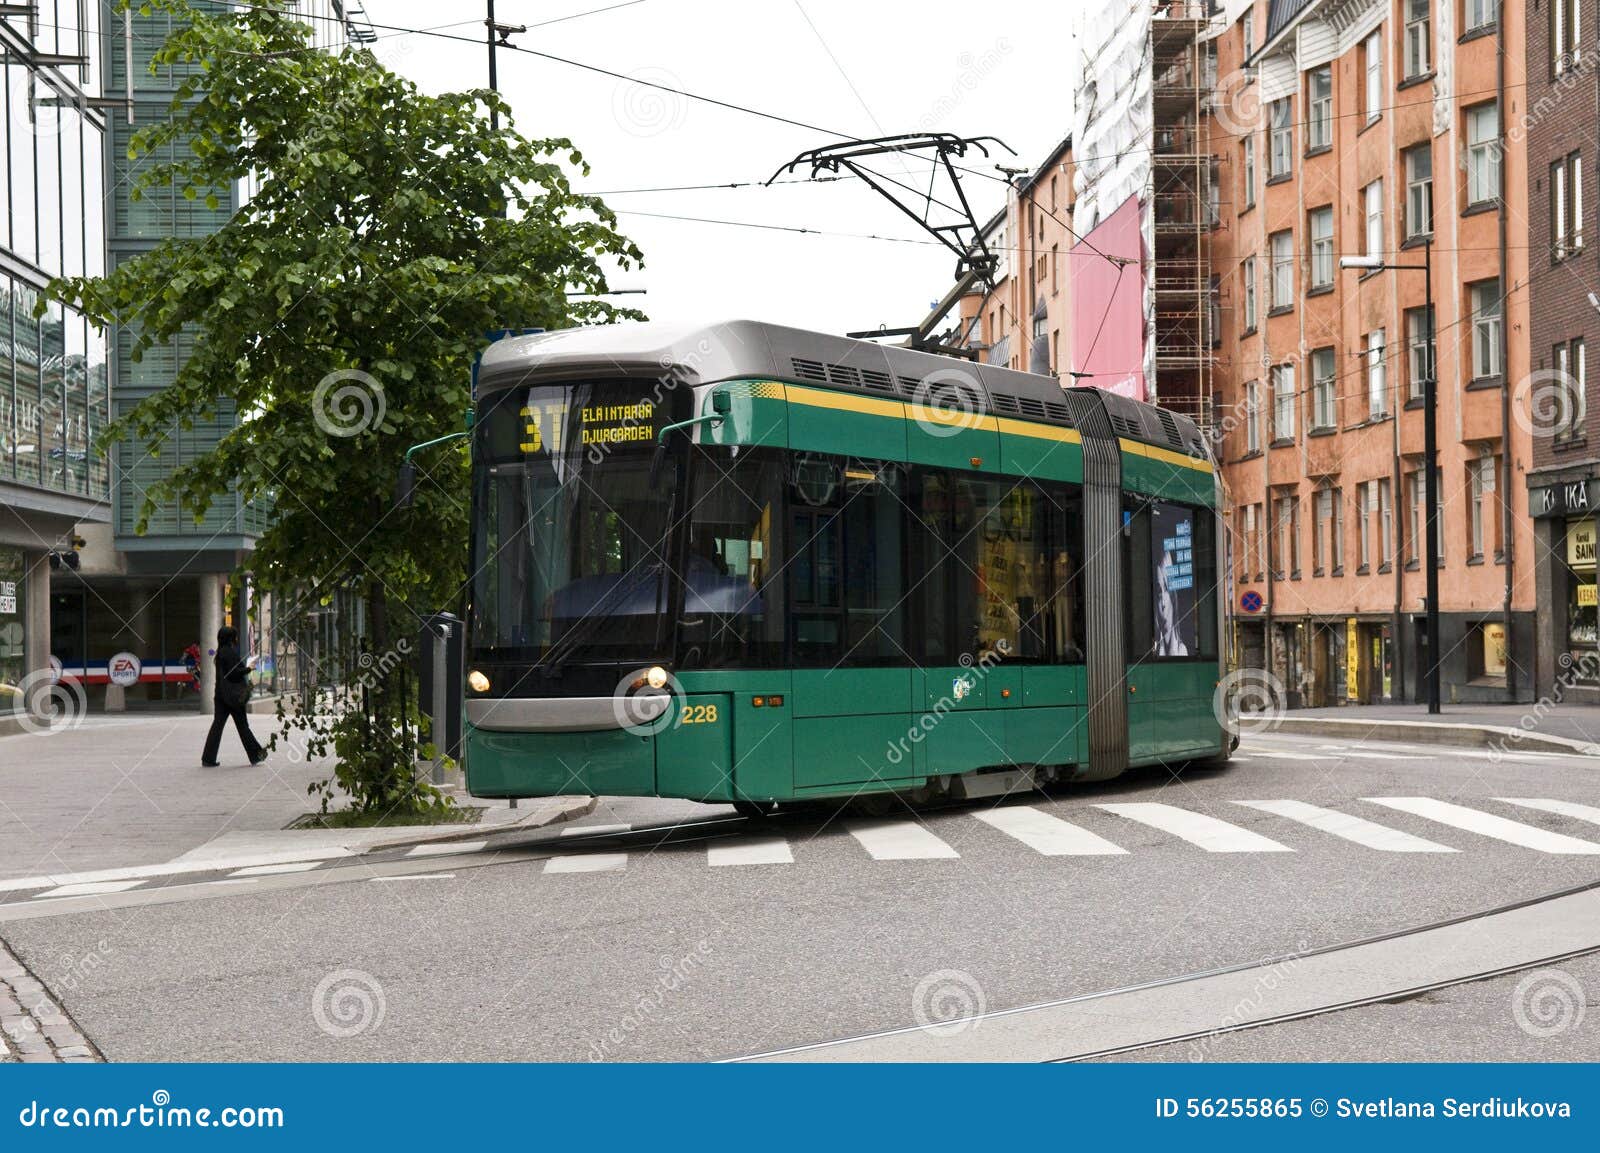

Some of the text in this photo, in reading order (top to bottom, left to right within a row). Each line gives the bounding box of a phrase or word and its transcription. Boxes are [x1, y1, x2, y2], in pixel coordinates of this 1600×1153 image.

[519, 404, 568, 453] 3T
[114, 660, 135, 671] EA
[681, 704, 718, 724] 228
